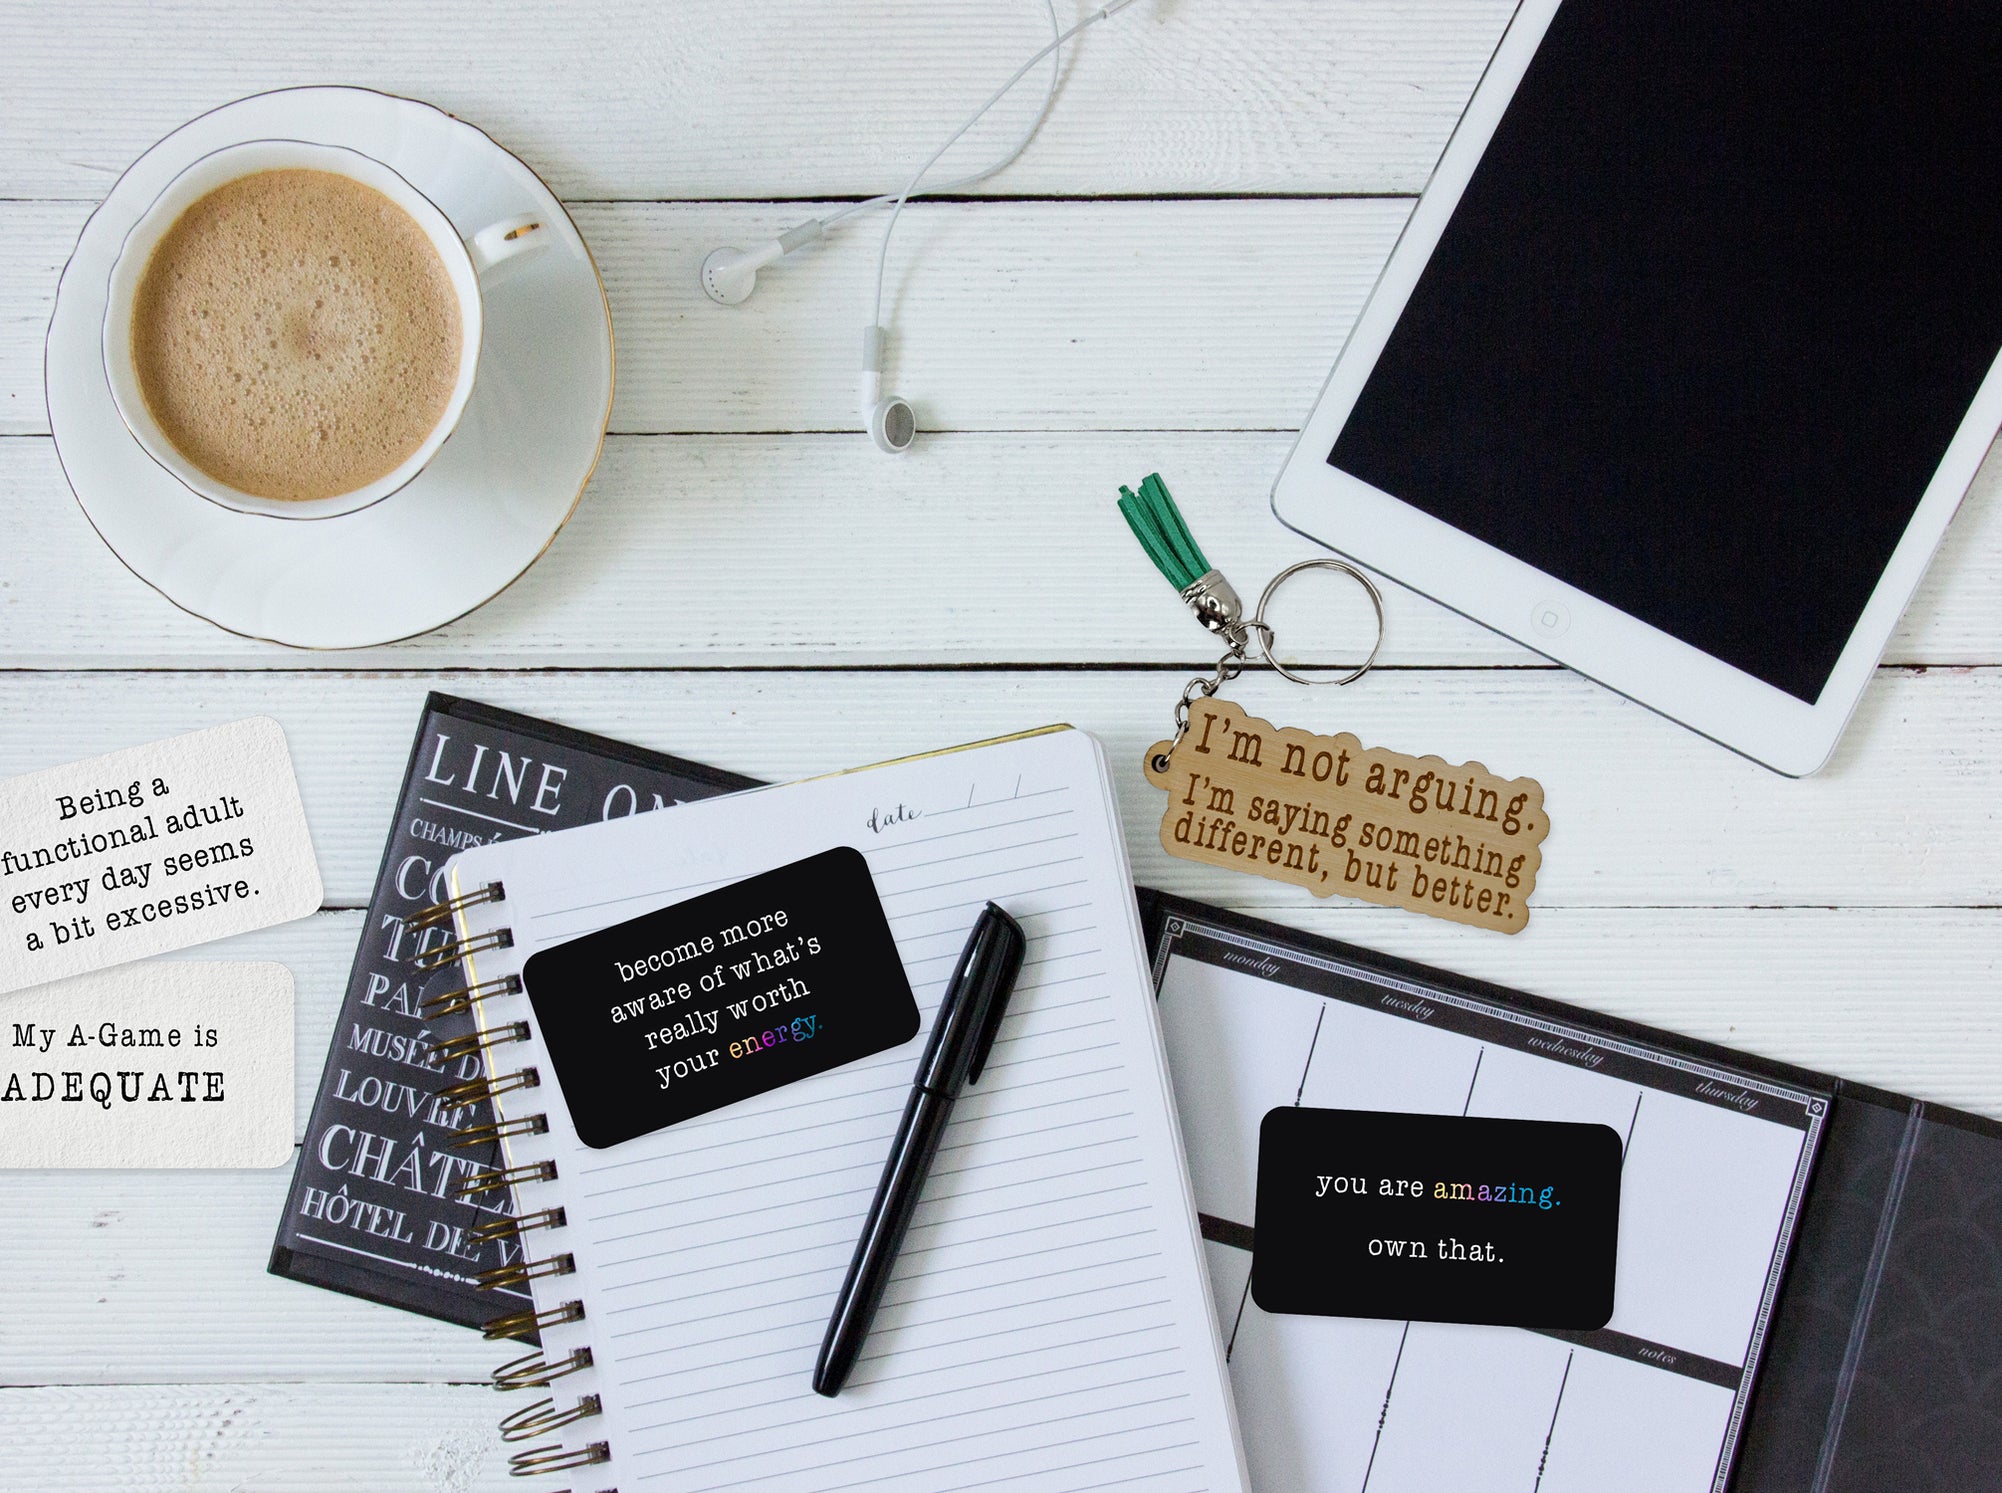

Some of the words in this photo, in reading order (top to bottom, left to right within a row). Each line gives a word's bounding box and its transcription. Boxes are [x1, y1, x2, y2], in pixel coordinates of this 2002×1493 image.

[55, 781, 145, 821] Being
[151, 776, 170, 797] a
[425, 733, 568, 816] LINE
[1195, 713, 1262, 768] I’m
[1281, 742, 1350, 786] not
[1365, 762, 1535, 836] arguing.
[2, 815, 158, 876] functional
[166, 795, 245, 835] adult
[410, 818, 483, 850] CHAMPS
[866, 803, 922, 834] date
[1183, 773, 1234, 816] I’m
[1248, 795, 1352, 849] saying
[1359, 821, 1526, 889] something
[11, 878, 90, 915] every
[101, 858, 153, 893] day
[164, 836, 255, 876] seems
[1175, 811, 1328, 883] different,
[1344, 849, 1398, 892] but
[1412, 864, 1514, 920] better.
[25, 932, 44, 952] a
[54, 916, 95, 944] bit
[106, 881, 260, 932] excessive.
[615, 936, 714, 982] become
[720, 910, 789, 947] more
[1223, 951, 1281, 977] monday
[610, 982, 692, 1023] aware
[700, 965, 726, 992] of
[729, 936, 822, 981] what’s
[644, 1009, 719, 1050] really
[726, 977, 811, 1020] worth
[1381, 994, 1435, 1021] tuesday
[12, 1023, 55, 1050] My
[67, 1022, 182, 1047] A-Game
[194, 1024, 218, 1047] is
[655, 1048, 719, 1089] your
[729, 1014, 823, 1059] energy.
[1527, 1035, 1604, 1068] wednesday
[1, 1071, 226, 1109] ADEQUATE
[1695, 1081, 1759, 1111] thursday
[300, 1184, 413, 1243] HÔTEL
[1315, 1171, 1368, 1198] you
[1379, 1177, 1425, 1198] are
[1433, 1179, 1562, 1210] amazing.
[1368, 1237, 1429, 1259] own
[1437, 1237, 1505, 1264] that.
[1638, 1347, 1677, 1364] notes
